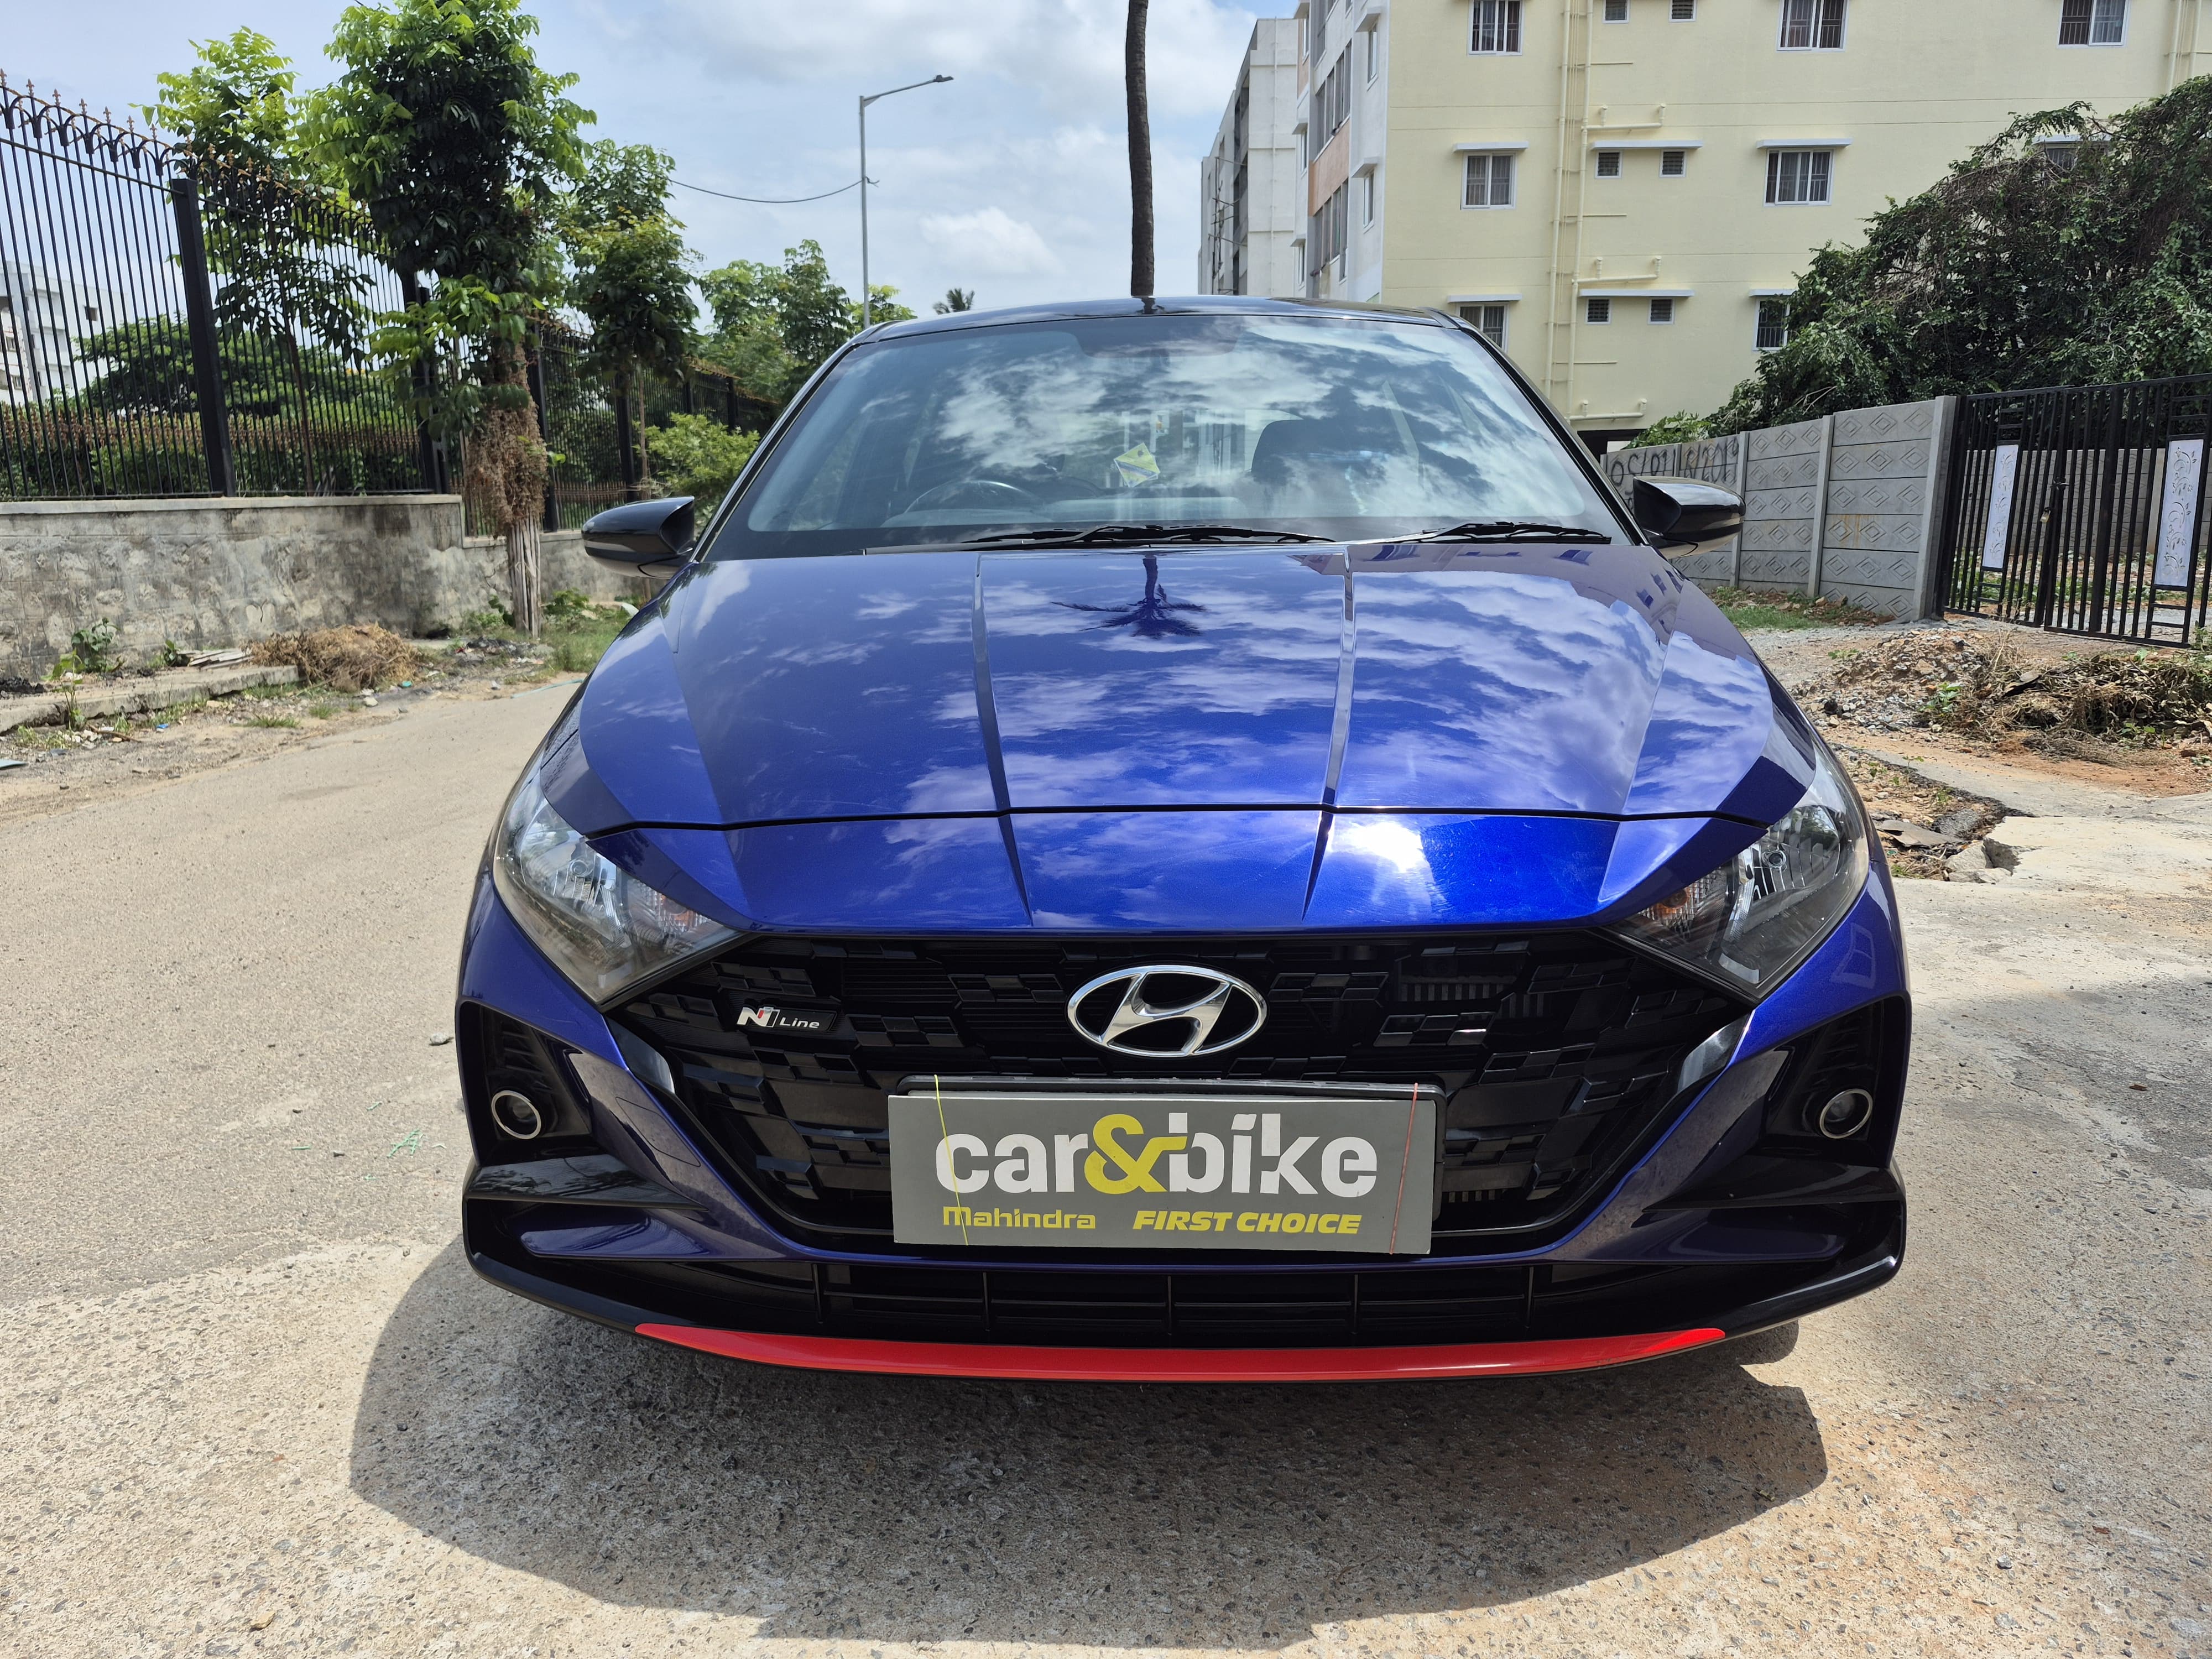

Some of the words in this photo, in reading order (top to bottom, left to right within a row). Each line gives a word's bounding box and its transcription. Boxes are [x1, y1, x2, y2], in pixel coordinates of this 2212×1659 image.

[779, 1017, 820, 1029] Line
[936, 1112, 1378, 1198] car&bike
[943, 1206, 1097, 1230] Mahindra
[1132, 1211, 1233, 1232] FIRST
[1236, 1212, 1363, 1235] CHOICE
